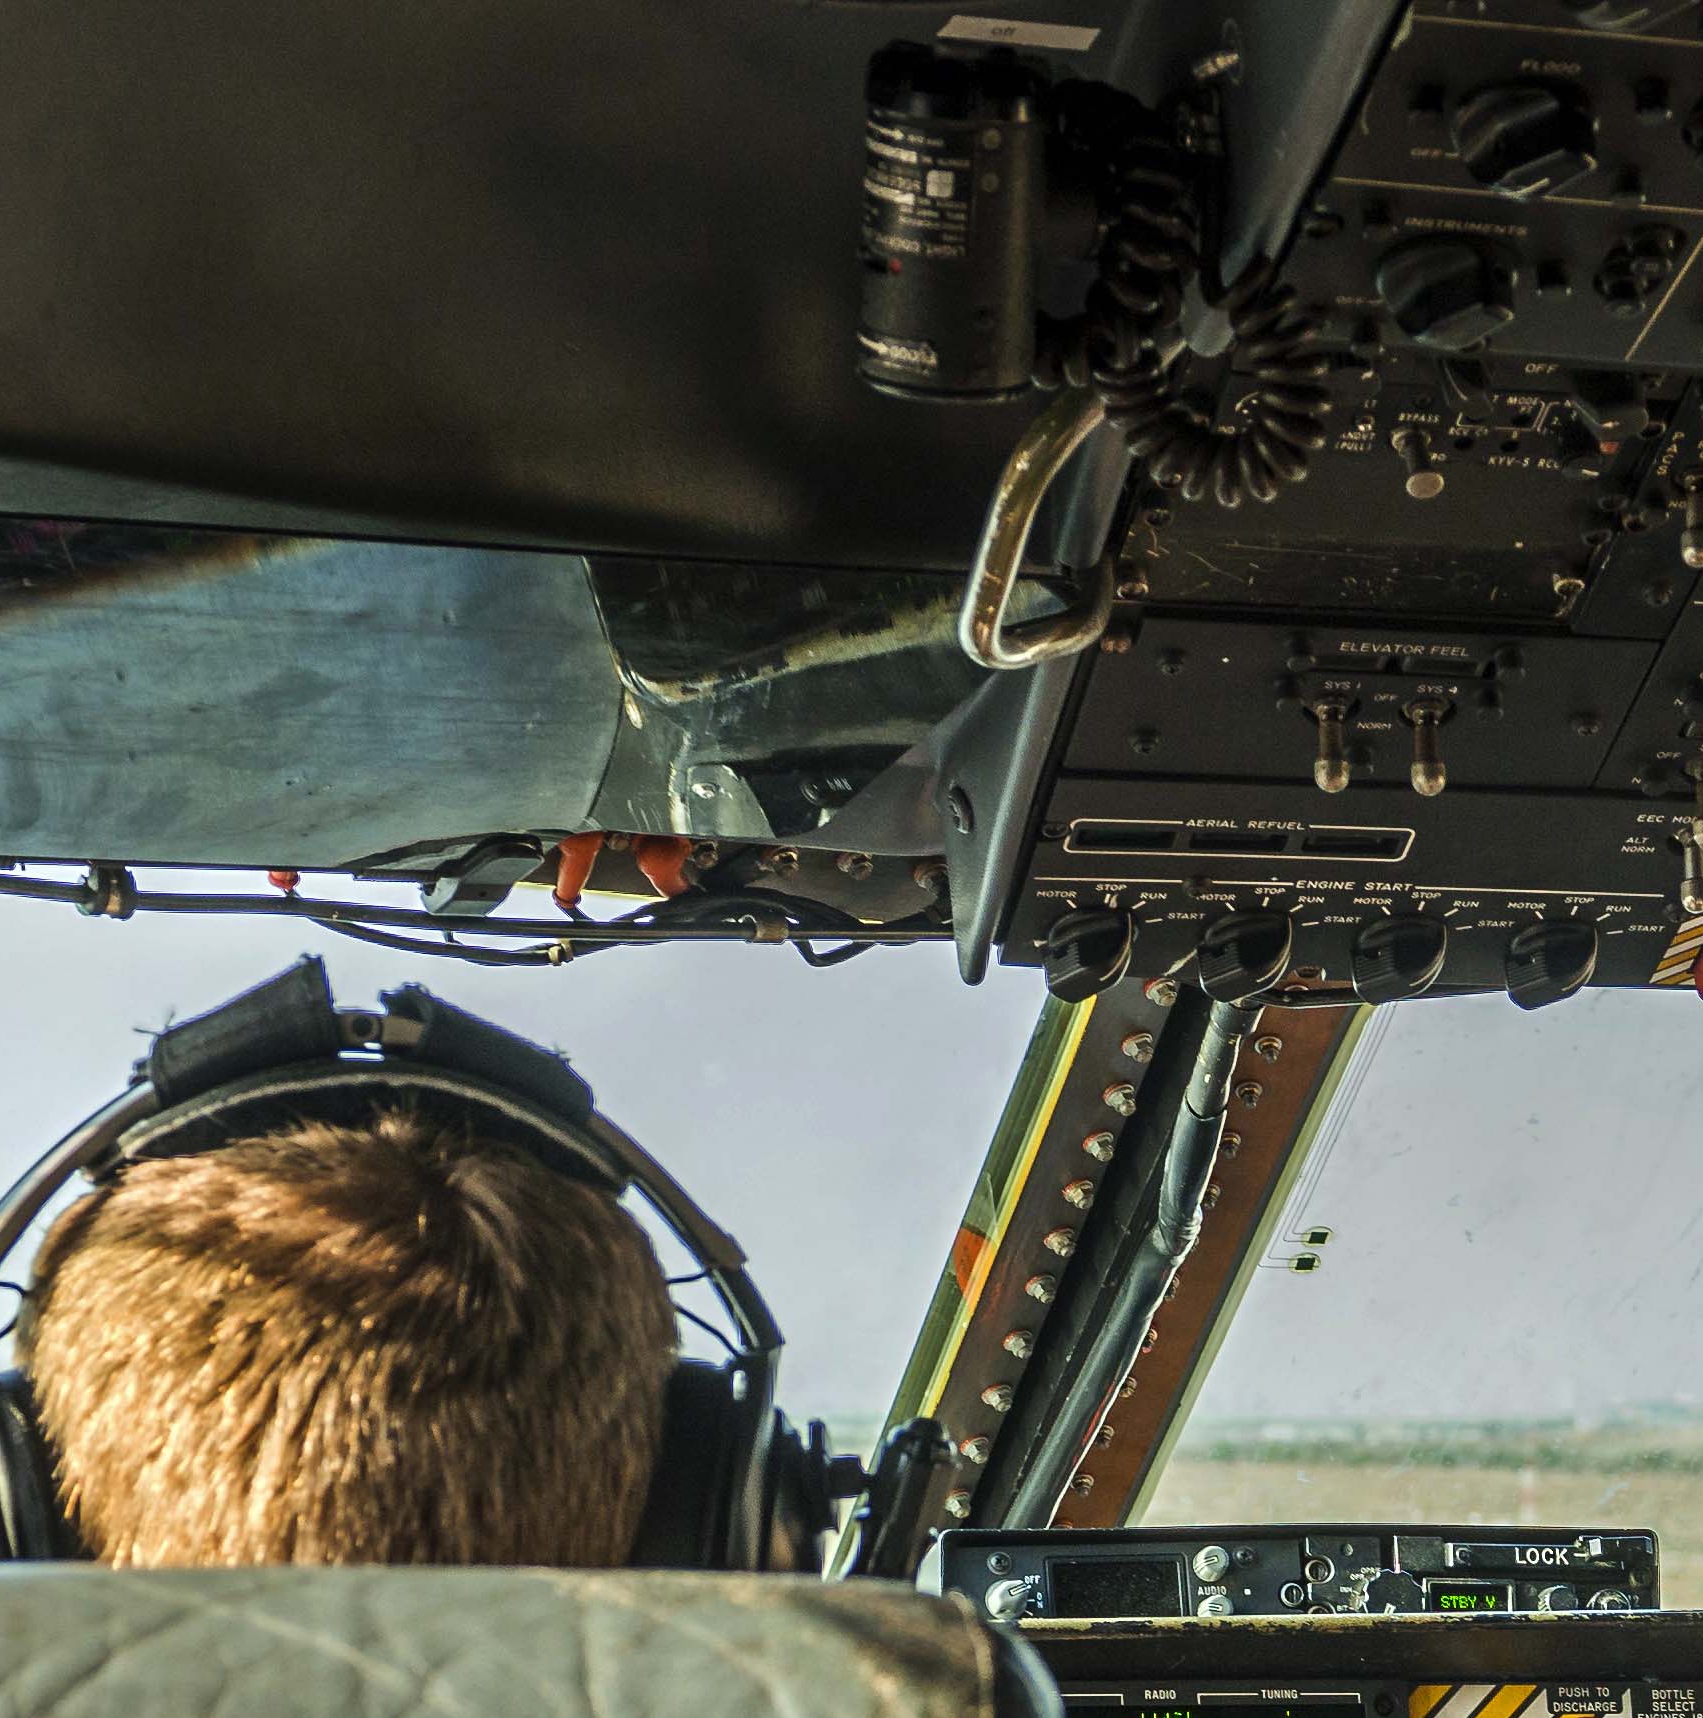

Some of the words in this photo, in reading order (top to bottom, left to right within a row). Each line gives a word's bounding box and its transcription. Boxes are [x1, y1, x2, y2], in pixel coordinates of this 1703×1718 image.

[1340, 642, 1424, 655] ELEVATOR
[1430, 646, 1469, 657] FEEL
[1185, 818, 1239, 829] AERIAL
[1248, 820, 1305, 830] REFUEL
[1095, 883, 1128, 892] STOP
[1296, 880, 1355, 891] ENGINE
[1365, 881, 1412, 892] START
[1035, 889, 1077, 900] MOTOR
[1139, 891, 1168, 901] RUN
[1167, 911, 1206, 921] START
[1515, 1548, 1569, 1565] LOCK
[1198, 1586, 1227, 1595] AUDIO
[1441, 1595, 1476, 1609] STBY
[1145, 1690, 1176, 1700] RADIO
[1261, 1689, 1297, 1699] TUNING
[1559, 1687, 1590, 1697] PUSH
[1596, 1687, 1609, 1697] TO
[1652, 1690, 1694, 1700] BOTTLE
[1553, 1702, 1617, 1712] DISCHARGE
[1652, 1702, 1695, 1712] SELECT
